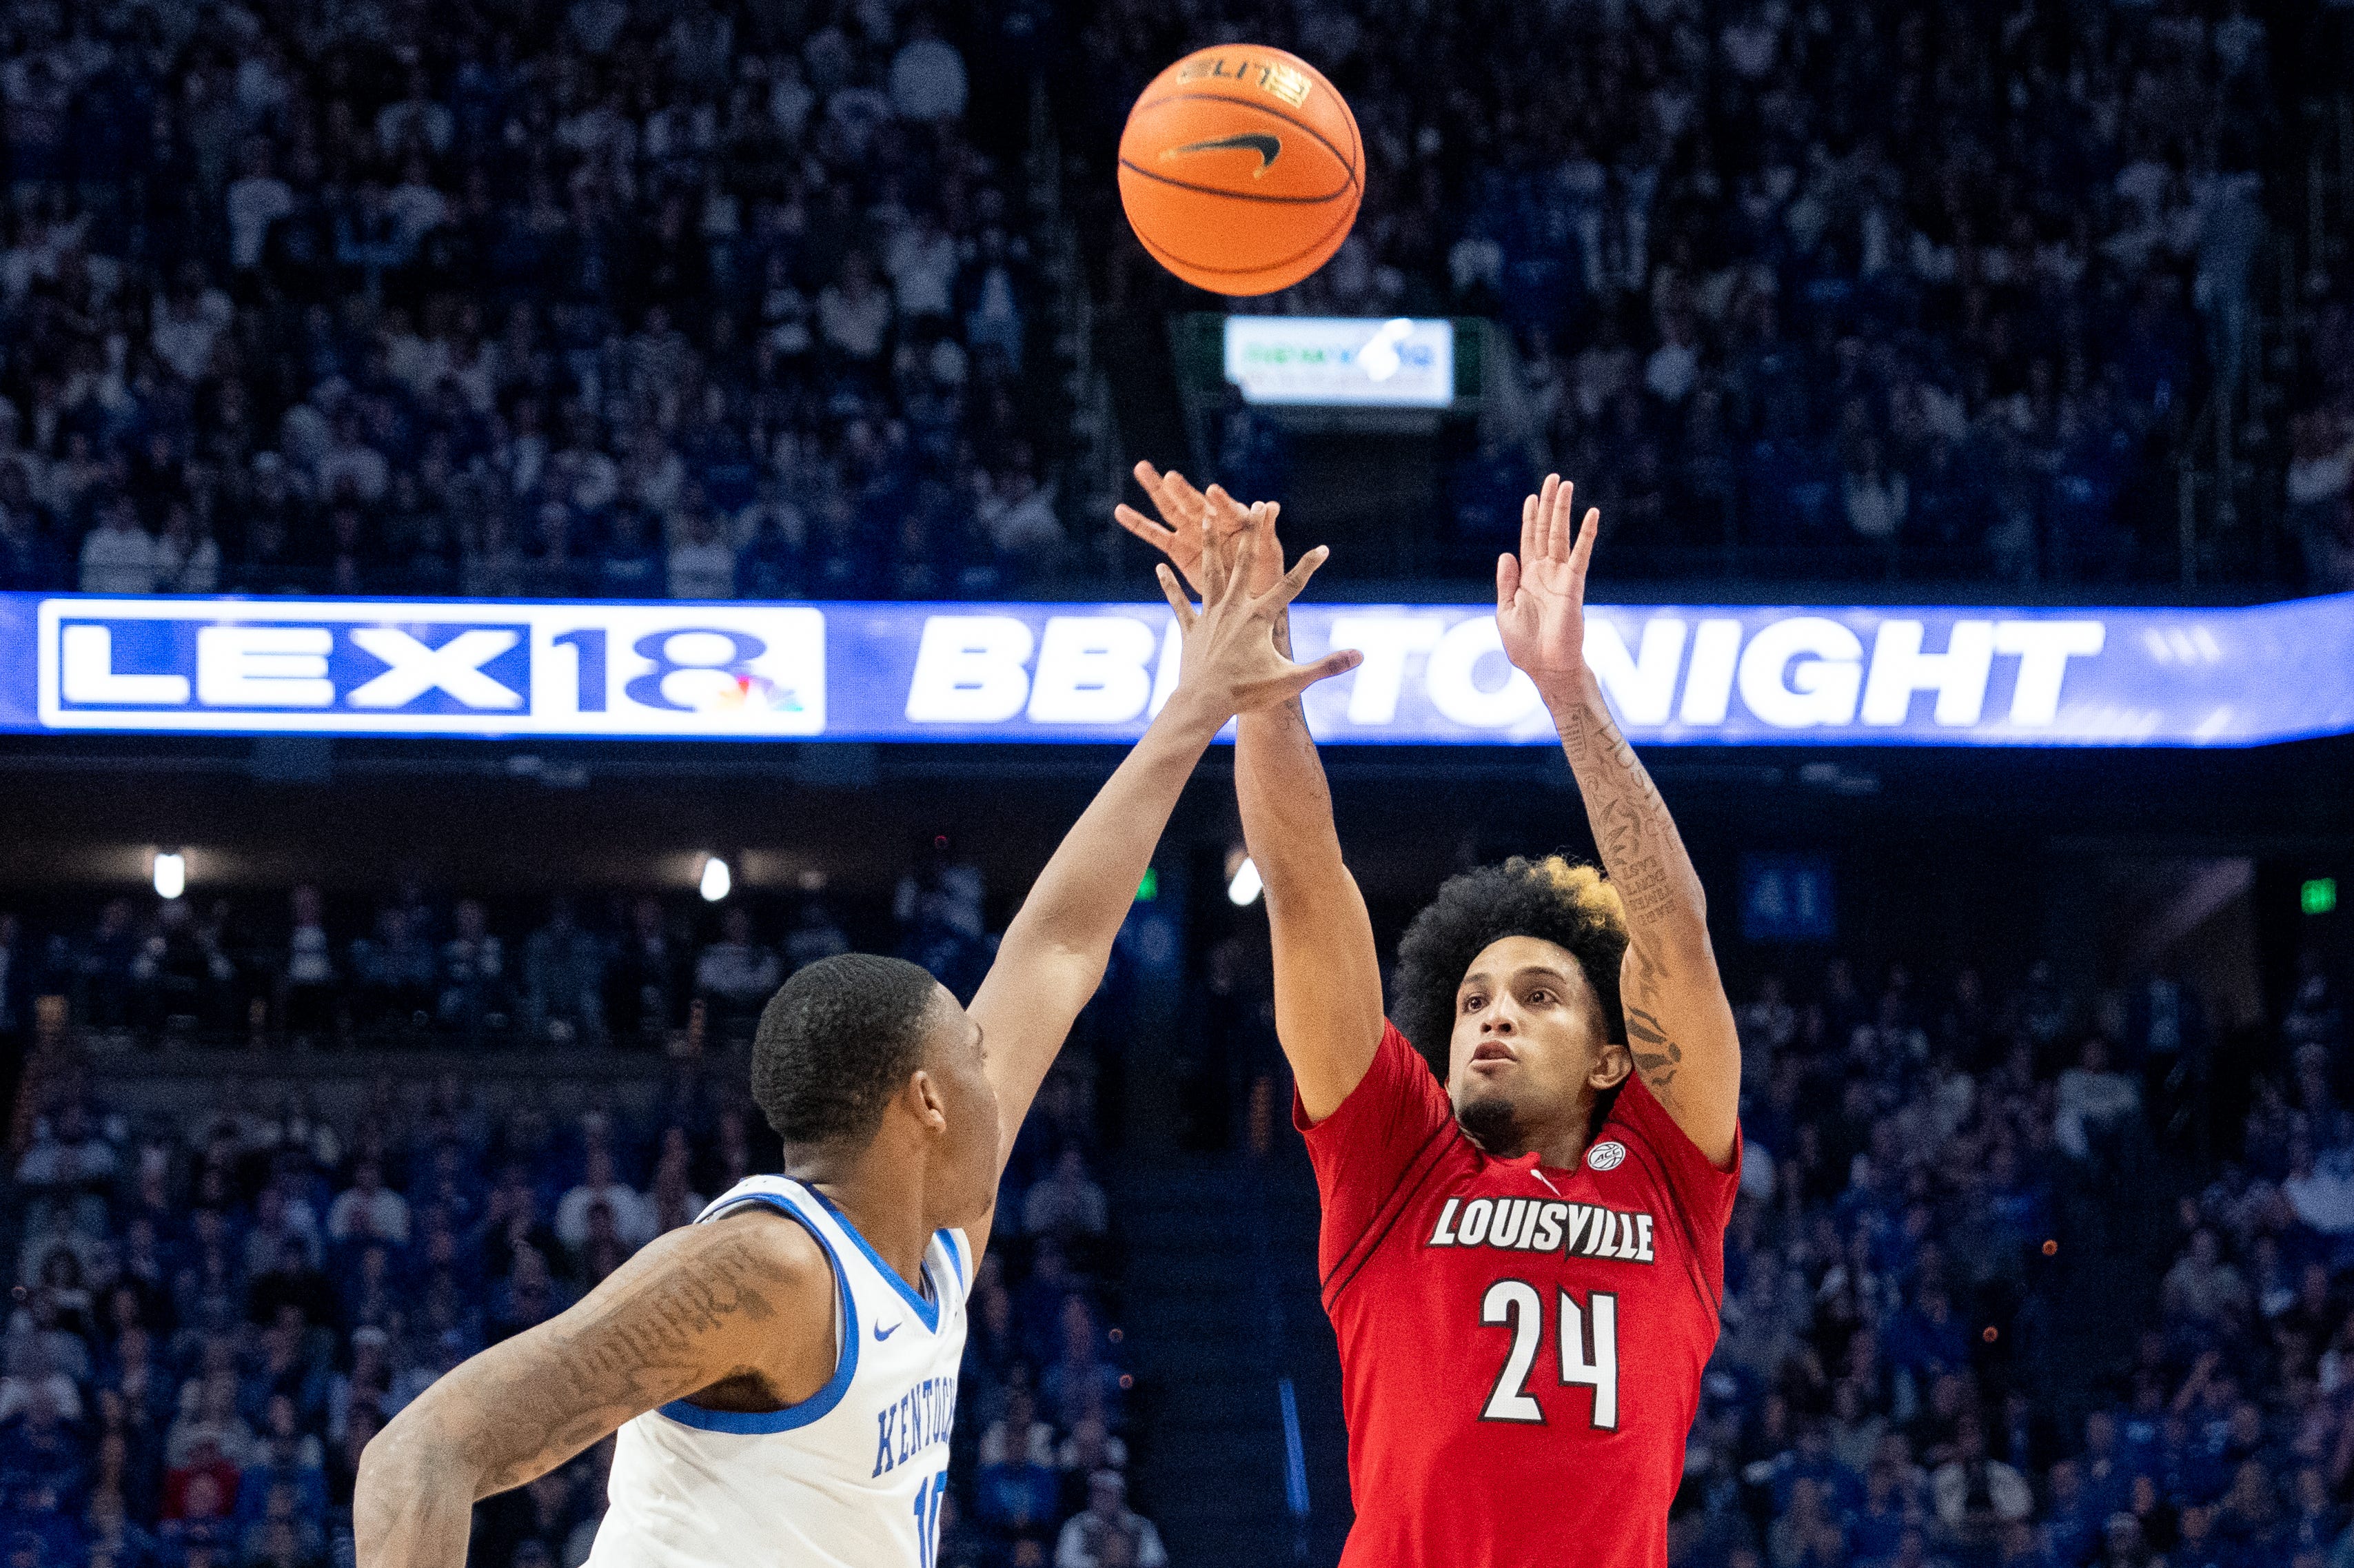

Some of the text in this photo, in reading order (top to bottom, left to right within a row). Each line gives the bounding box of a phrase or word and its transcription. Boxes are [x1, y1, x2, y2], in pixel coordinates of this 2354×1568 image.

[62, 624, 768, 713] LEX 18
[905, 616, 2106, 728] BB TONIGHT
[1594, 1146, 1621, 1164] ACC
[1427, 1196, 1654, 1263] LOUISVILLE
[1478, 1277, 1618, 1433] 24
[872, 1377, 955, 1478] KENTUC
